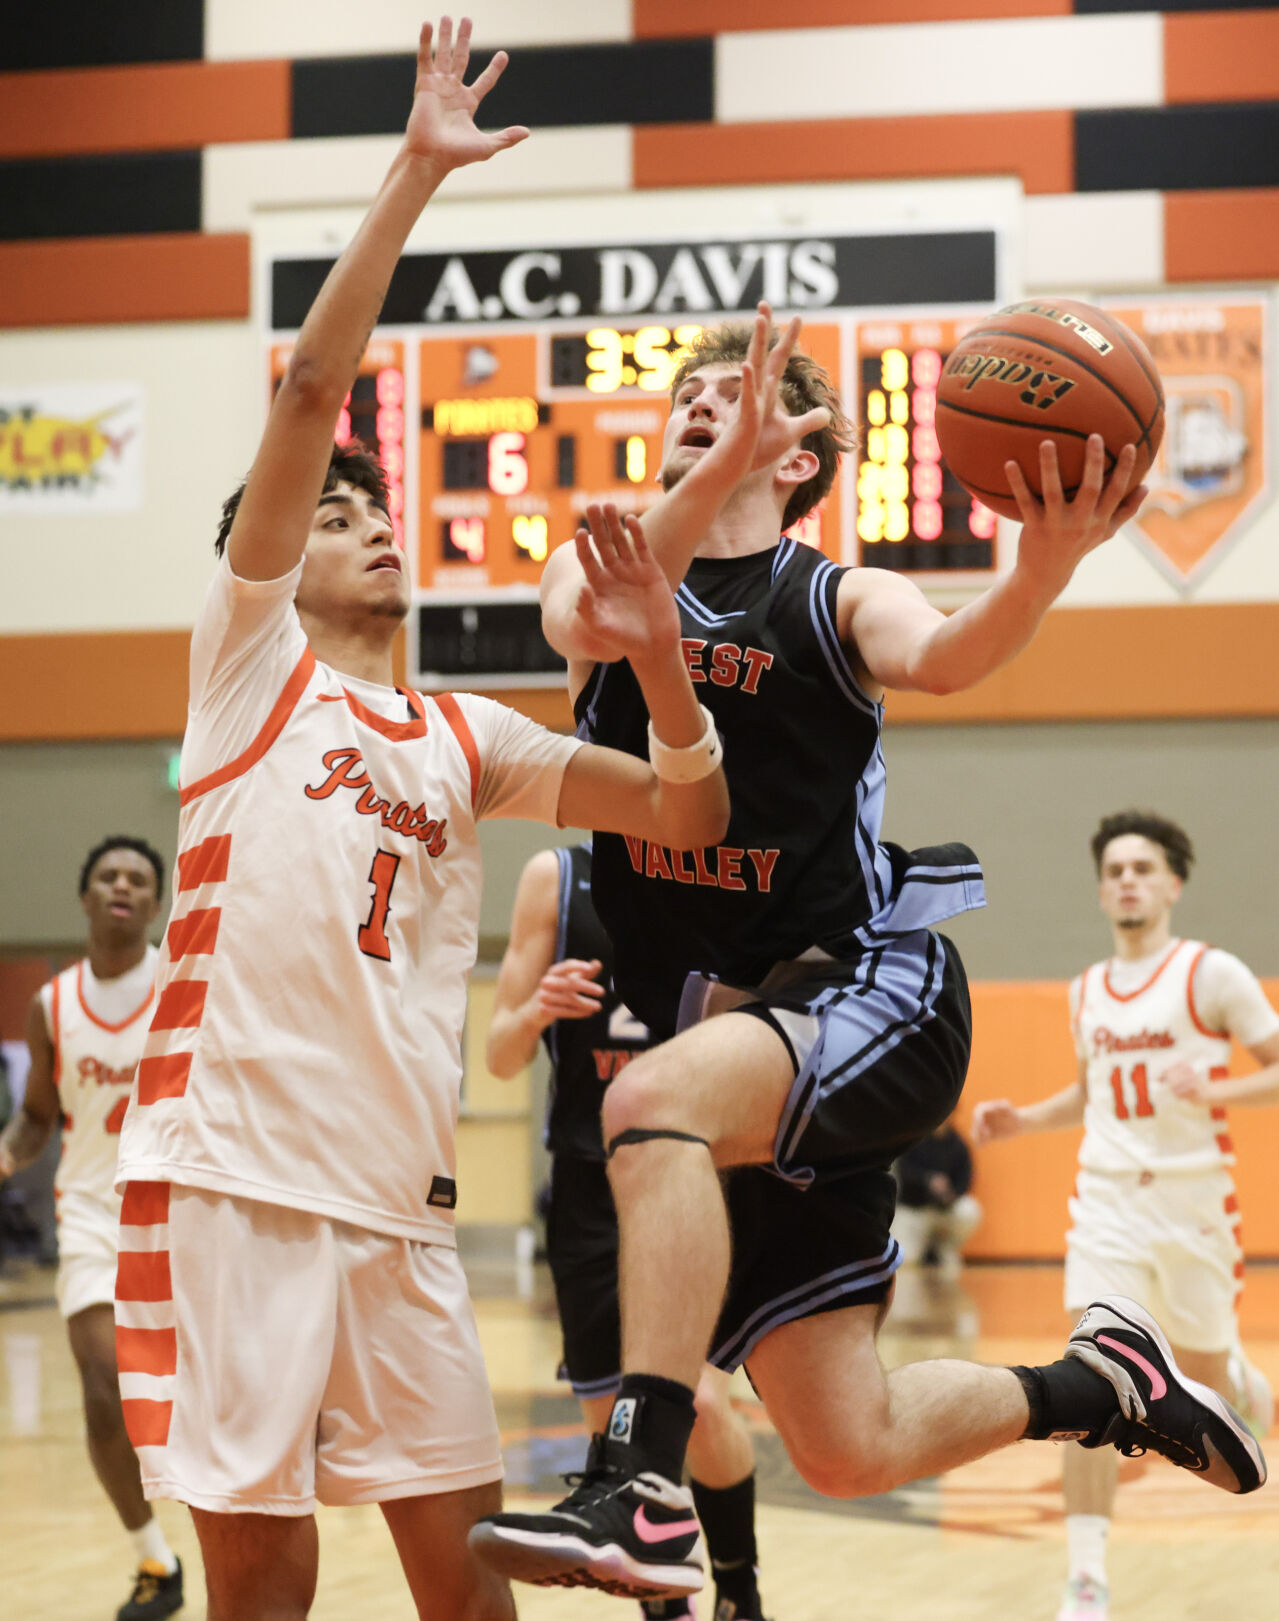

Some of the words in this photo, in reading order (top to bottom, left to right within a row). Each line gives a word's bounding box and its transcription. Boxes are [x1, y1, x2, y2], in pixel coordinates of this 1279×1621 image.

[424, 252, 581, 322] A.C.
[596, 240, 839, 314] DAVIS
[946, 352, 1077, 412] Baden
[488, 431, 528, 496] 6
[627, 436, 646, 483] 1
[451, 516, 485, 564] 4
[513, 515, 547, 562] 4
[680, 638, 774, 694] EST
[304, 747, 448, 858] Pirates
[623, 834, 780, 892] VALLEY
[358, 847, 402, 962] 1
[1110, 1062, 1155, 1120] 11
